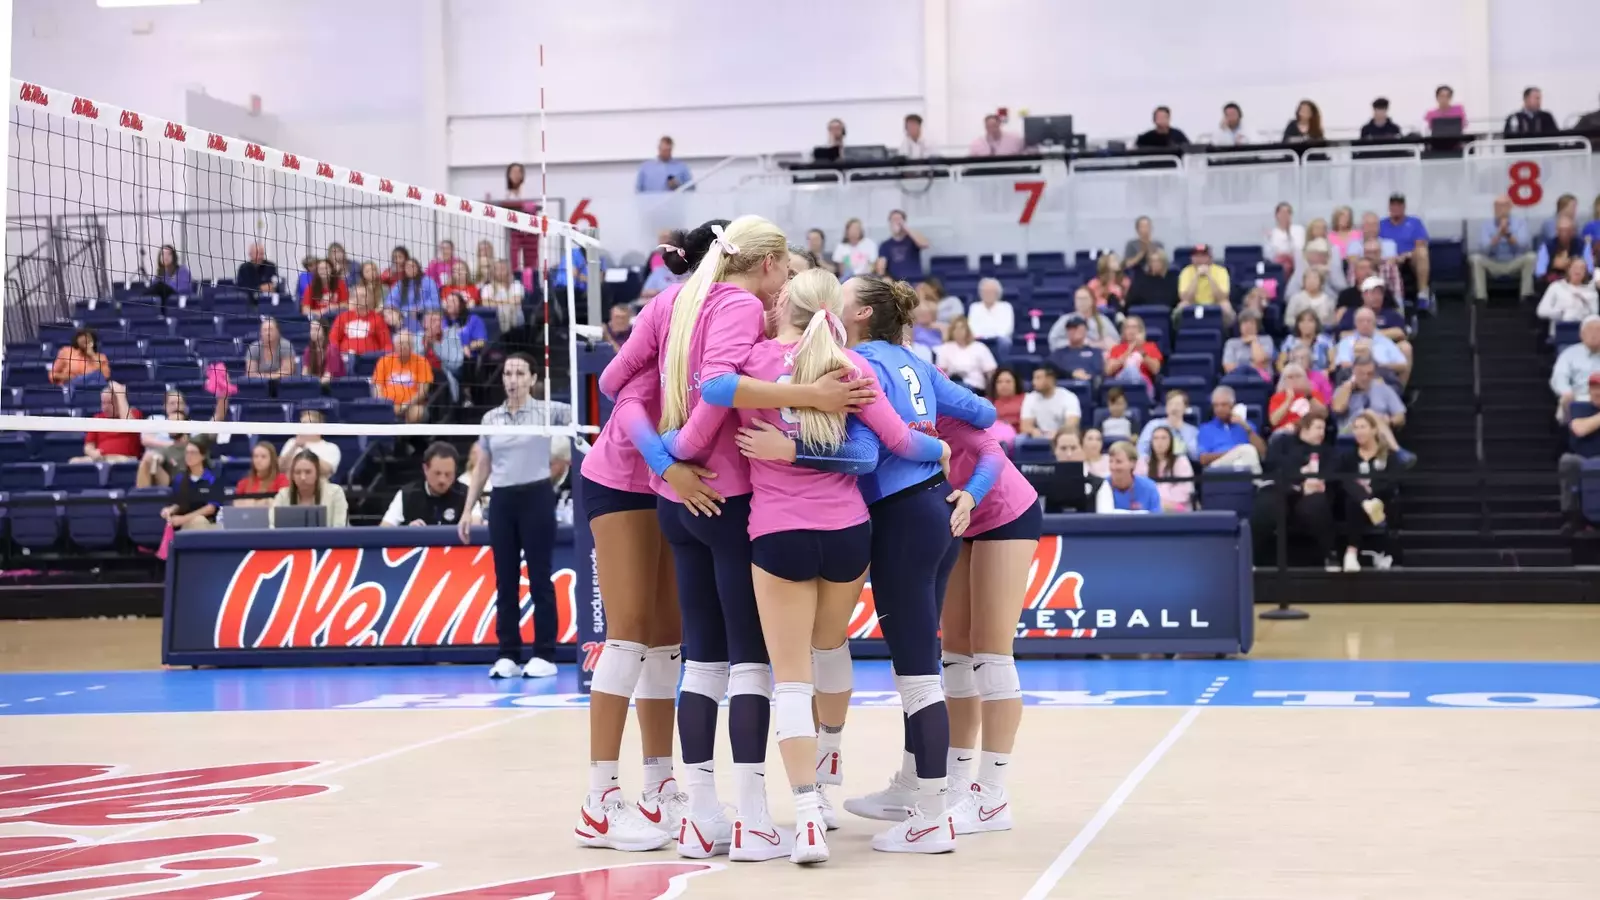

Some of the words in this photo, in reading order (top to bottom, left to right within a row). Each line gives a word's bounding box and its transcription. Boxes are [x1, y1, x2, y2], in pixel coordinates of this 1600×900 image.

[1014, 181, 1046, 224] 7
[1507, 161, 1543, 206] 8
[569, 199, 598, 228] 6
[898, 364, 928, 416] 2
